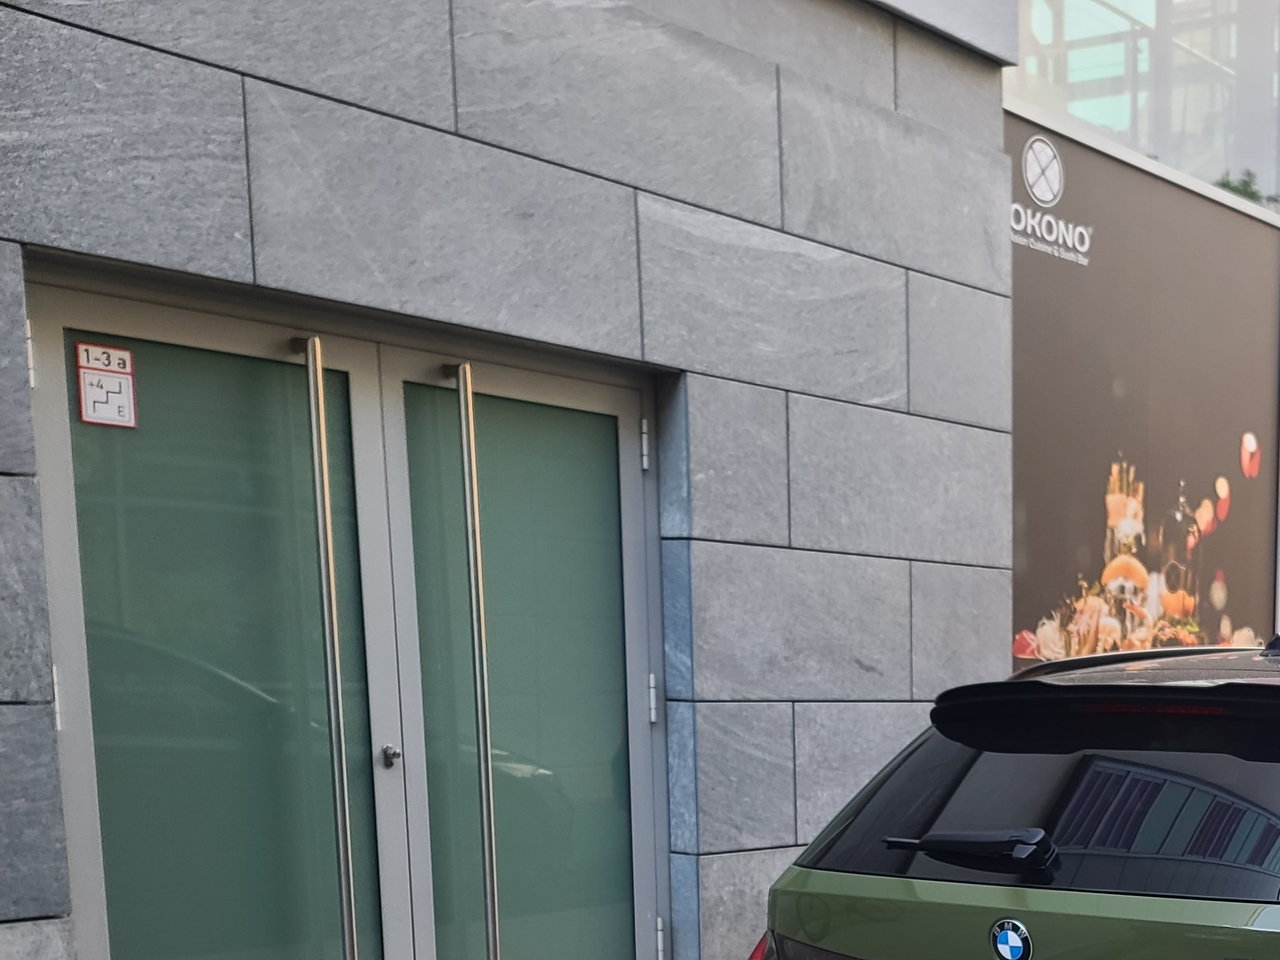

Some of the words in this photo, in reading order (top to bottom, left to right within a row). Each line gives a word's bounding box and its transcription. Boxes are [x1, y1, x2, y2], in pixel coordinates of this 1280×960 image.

[1009, 203, 1090, 253] OKONO
[84, 348, 111, 368] 1-3
[117, 357, 127, 370] a
[118, 405, 126, 417] E
[992, 921, 1028, 940] BMW
